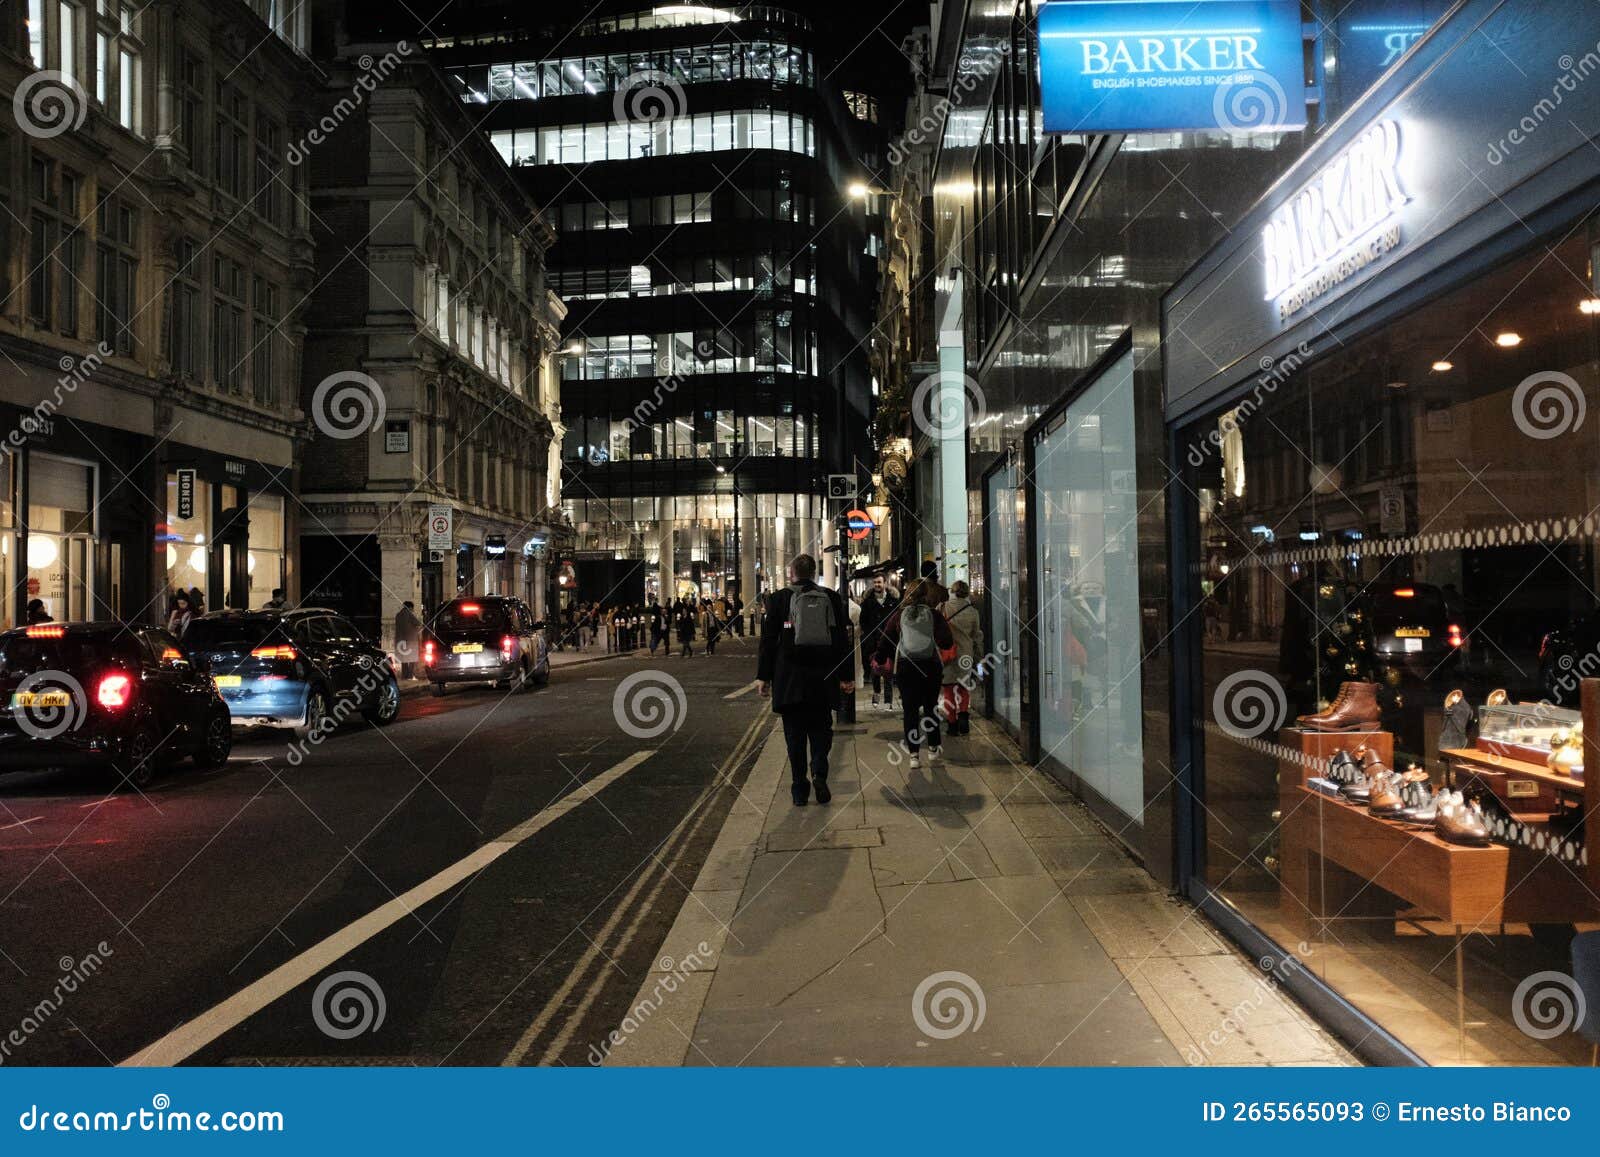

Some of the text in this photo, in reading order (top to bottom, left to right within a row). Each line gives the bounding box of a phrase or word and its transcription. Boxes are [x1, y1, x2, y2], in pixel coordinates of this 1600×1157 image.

[1080, 35, 1265, 75] BARKER
[1093, 77, 1135, 89] ENGLISH
[1137, 75, 1202, 88] SHOEMAKERS
[1204, 75, 1233, 85] SINCE
[1263, 119, 1413, 302] BARKER
[181, 474, 191, 516] HONEST
